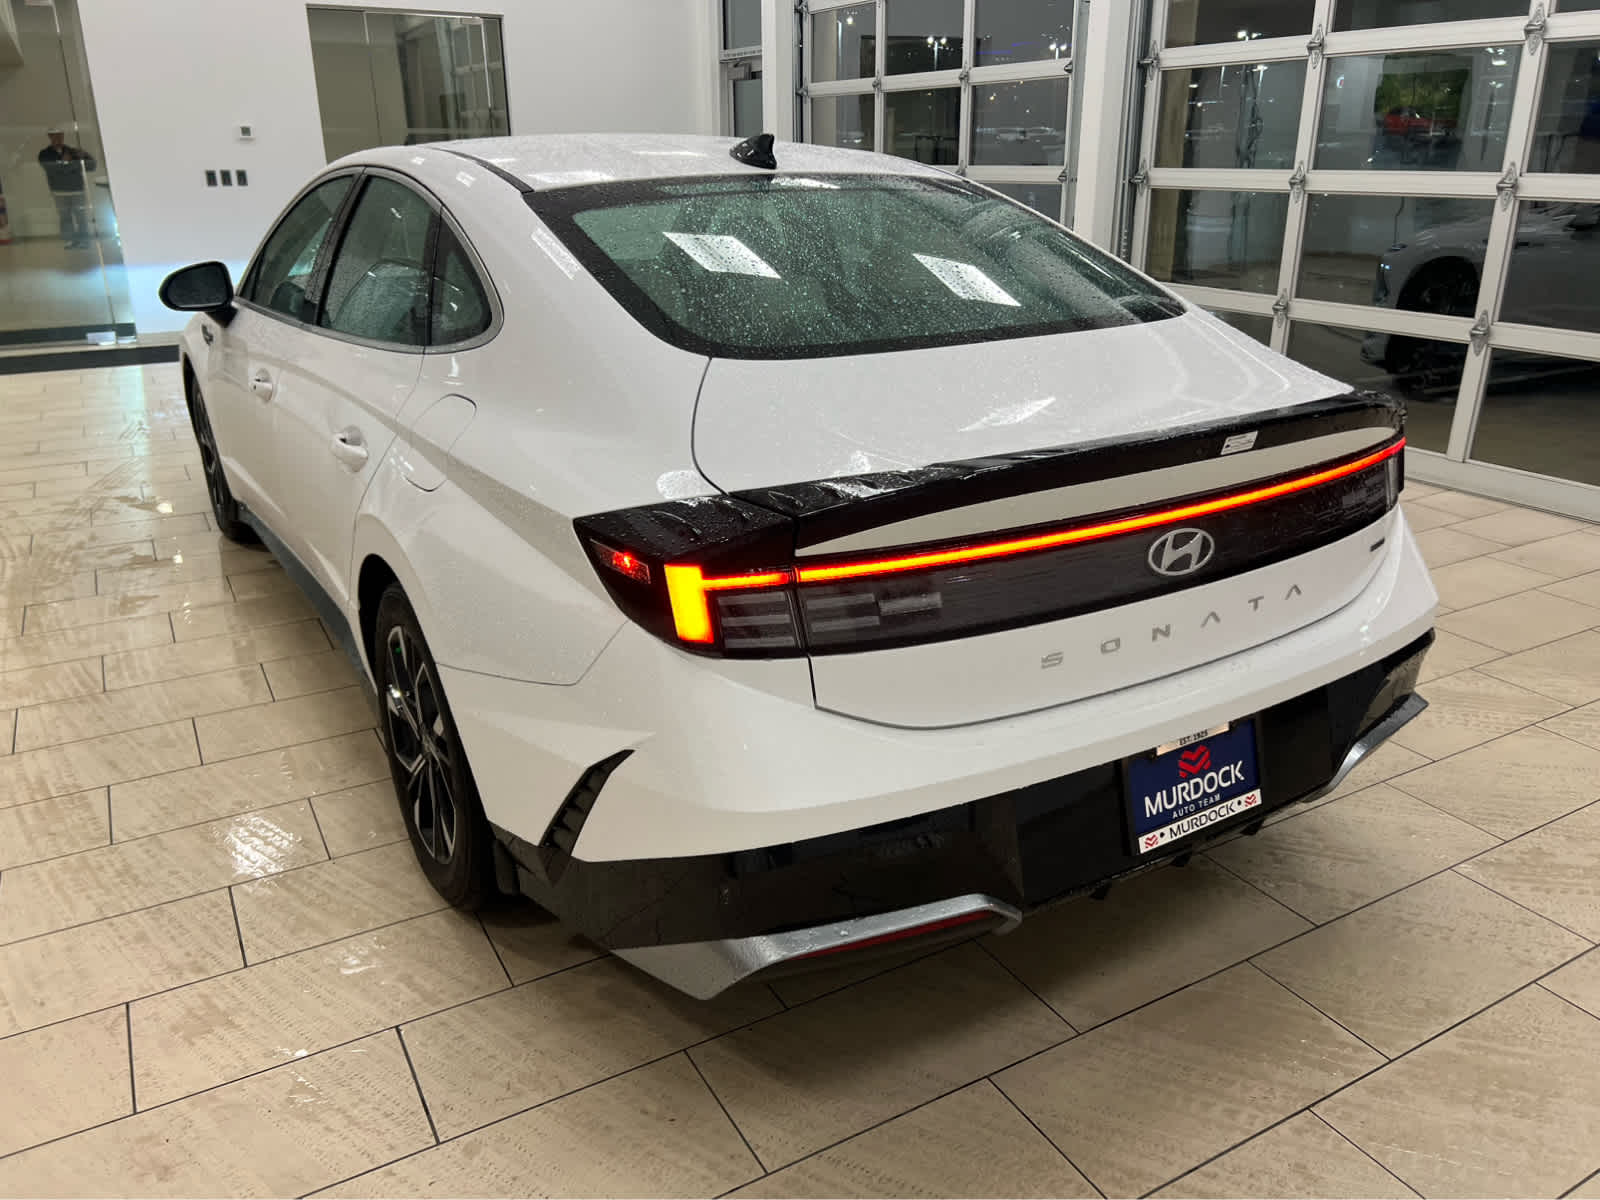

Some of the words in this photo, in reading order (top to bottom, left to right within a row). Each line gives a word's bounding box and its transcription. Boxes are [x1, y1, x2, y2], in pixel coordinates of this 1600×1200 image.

[1041, 584, 1302, 670] SONATA
[1144, 760, 1245, 818] MURDOCK
[1172, 804, 1196, 819] AUTO
[1199, 793, 1221, 808] TEAM
[1169, 801, 1236, 839] MURDOCK
